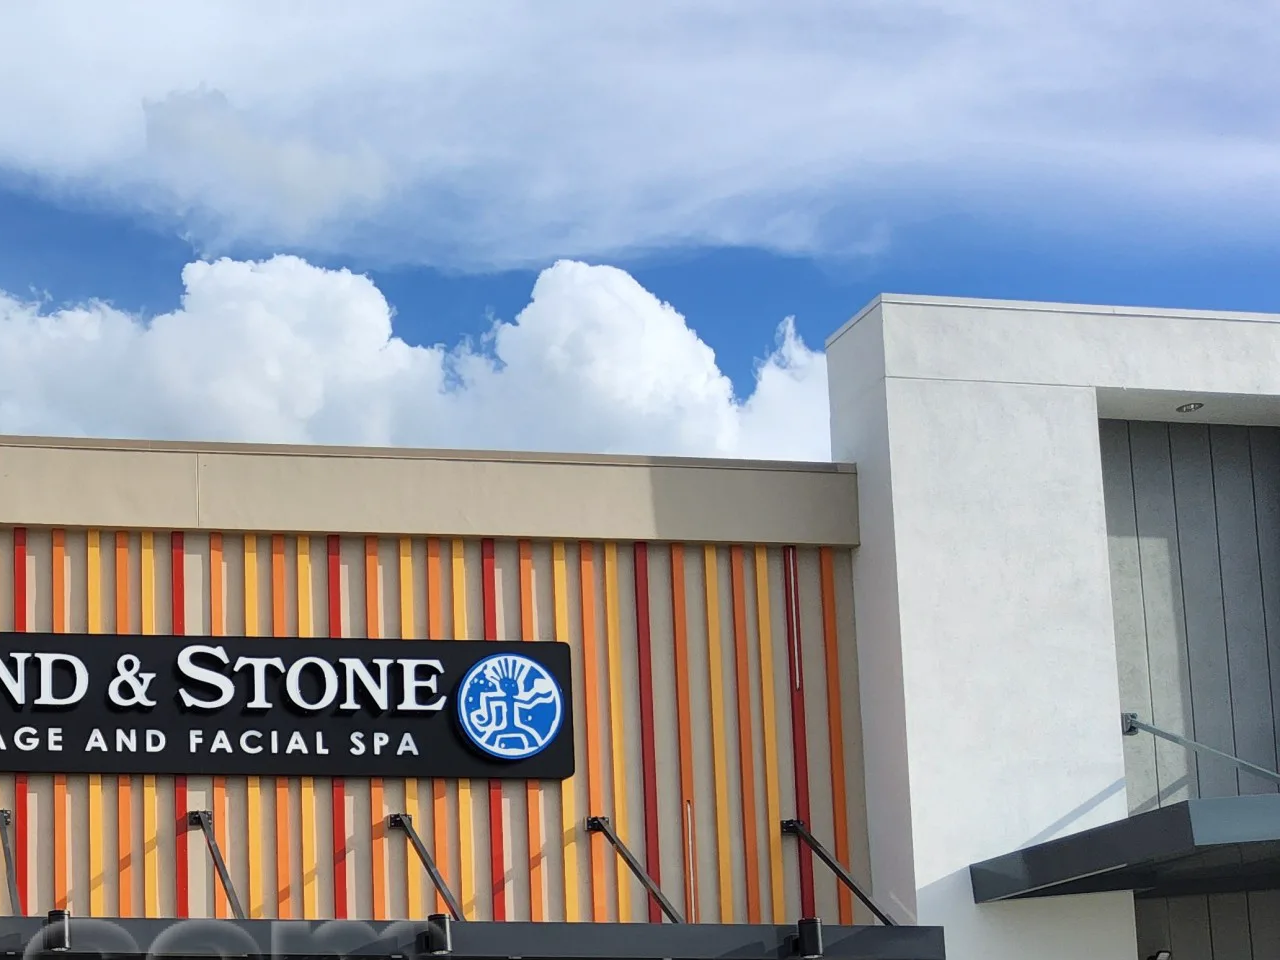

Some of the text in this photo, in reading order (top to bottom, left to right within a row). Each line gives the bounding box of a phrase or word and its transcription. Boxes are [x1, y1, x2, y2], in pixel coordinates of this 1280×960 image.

[109, 654, 156, 706] &
[178, 645, 447, 711] STONE
[86, 728, 166, 753] AND
[189, 730, 330, 755] FACIAL
[350, 731, 419, 756] SPA
